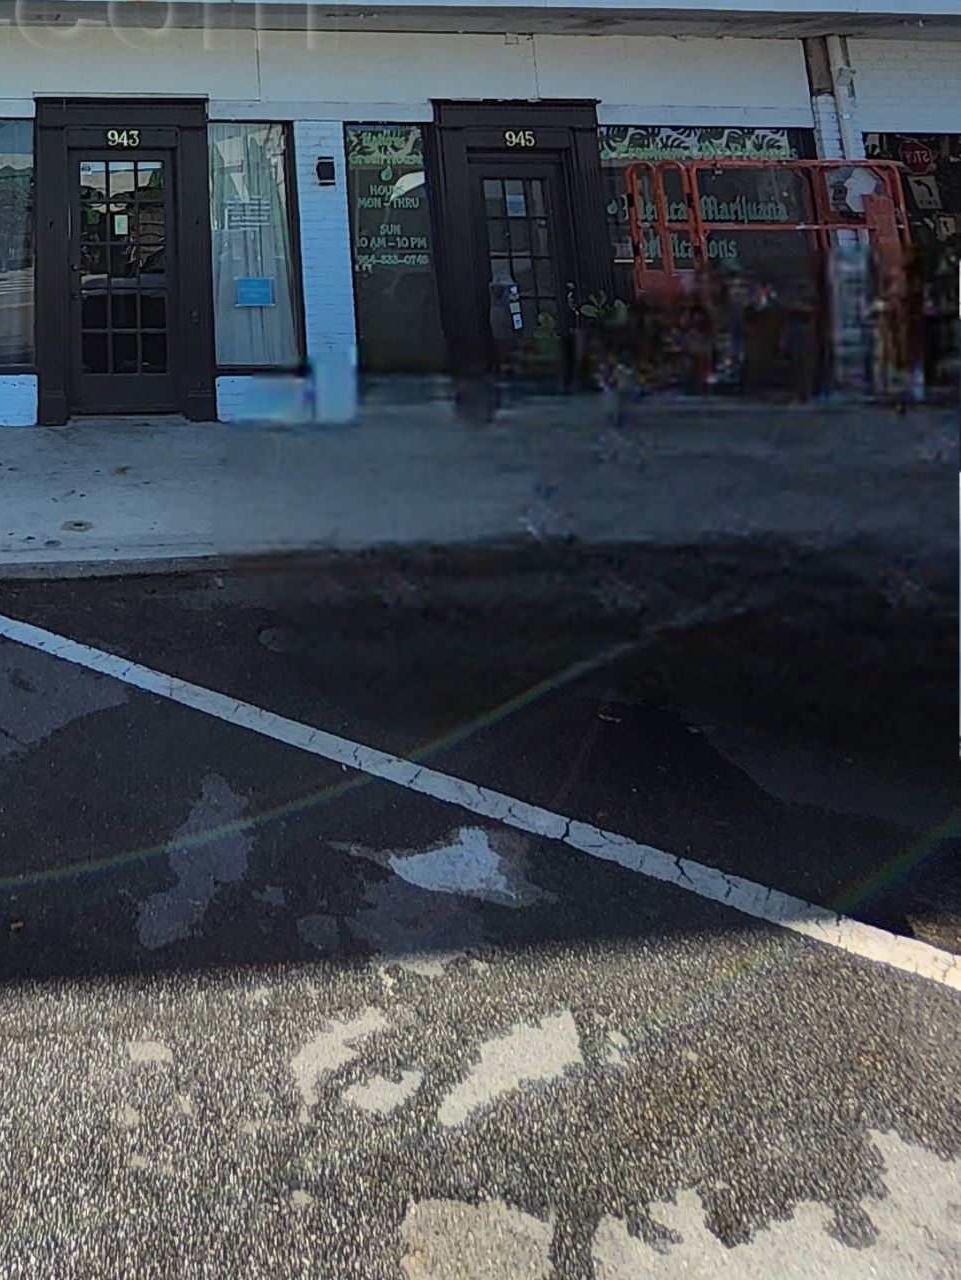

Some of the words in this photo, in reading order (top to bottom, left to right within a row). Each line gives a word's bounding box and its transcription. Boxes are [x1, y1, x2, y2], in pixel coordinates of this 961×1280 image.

[107, 130, 140, 147] 943
[505, 131, 536, 147] 945
[357, 197, 382, 209] MON
[393, 197, 420, 209] THRU
[621, 194, 694, 221] eica
[700, 194, 789, 224] Marijuana
[379, 224, 402, 236] SUN
[370, 236, 387, 249] AM
[410, 237, 427, 250] PM
